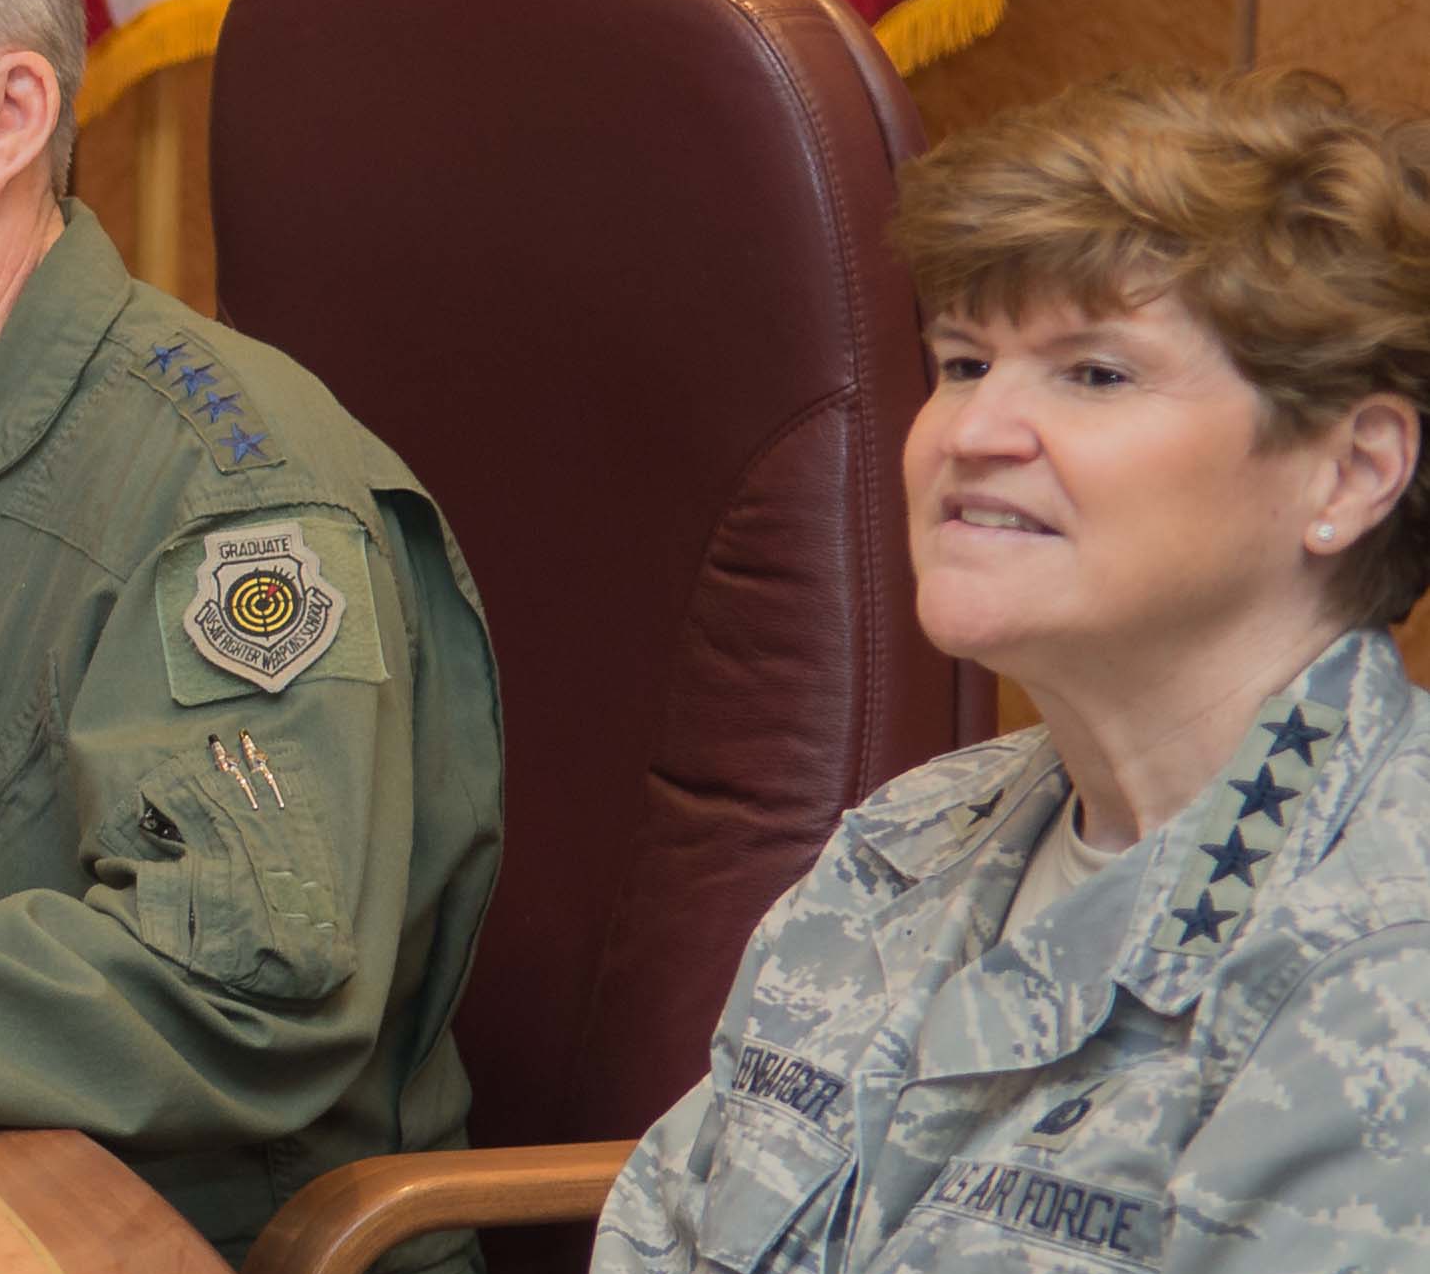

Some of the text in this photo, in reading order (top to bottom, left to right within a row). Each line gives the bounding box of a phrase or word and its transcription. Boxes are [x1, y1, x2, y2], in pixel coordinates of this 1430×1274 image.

[220, 537, 290, 559] GRADUATE
[218, 637, 260, 665] FIGHTER
[262, 633, 306, 671] WEAPONS
[963, 1165, 1021, 1217] AIR
[1015, 1176, 1142, 1253] FORCE
